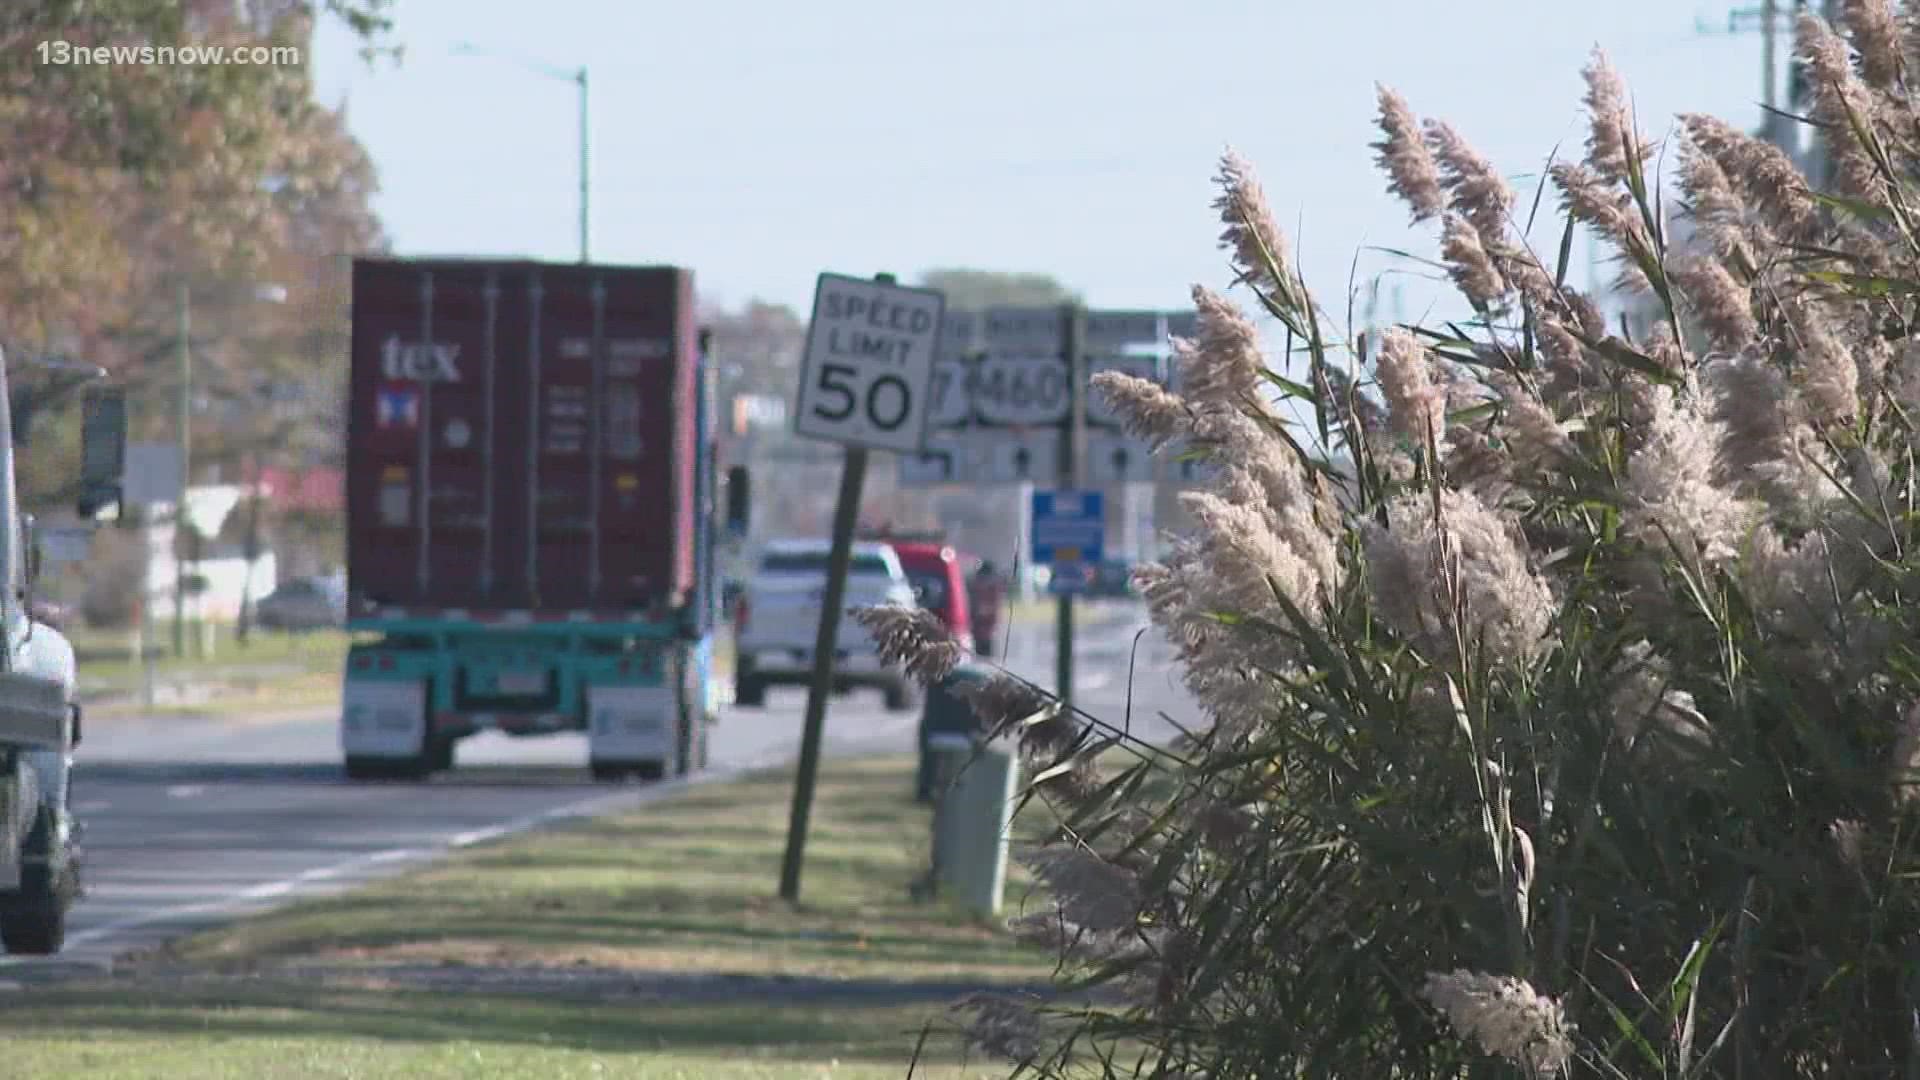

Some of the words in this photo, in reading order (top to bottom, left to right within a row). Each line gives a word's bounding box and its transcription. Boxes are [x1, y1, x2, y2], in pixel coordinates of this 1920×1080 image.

[824, 291, 932, 334] SPEED
[381, 334, 461, 381] tex
[829, 328, 913, 366] LIMIT
[813, 363, 911, 432] 50
[980, 365, 1066, 409] 460
